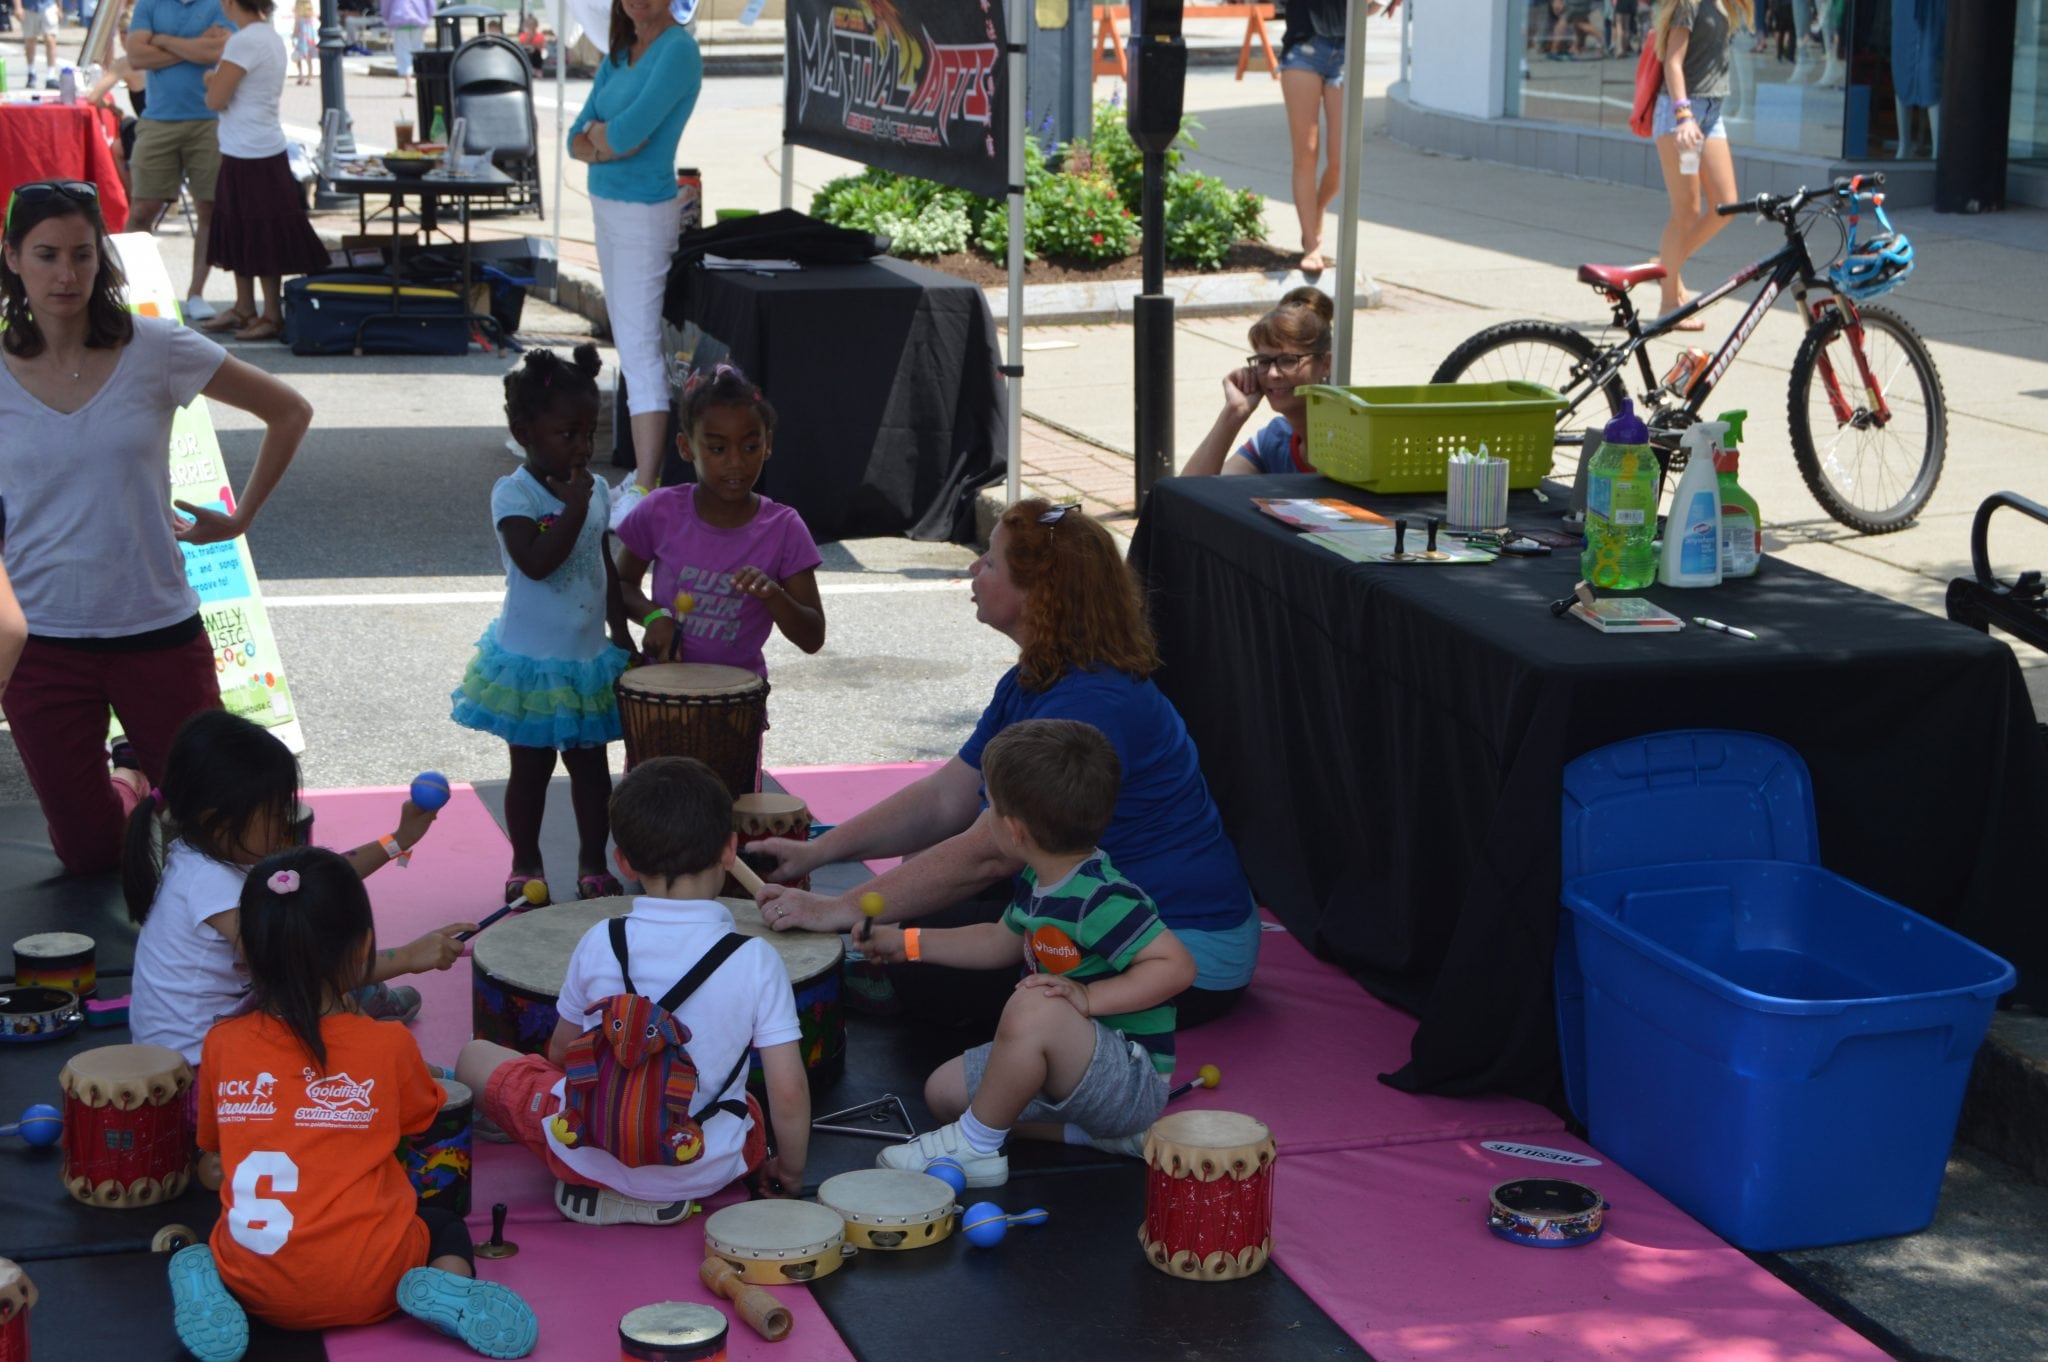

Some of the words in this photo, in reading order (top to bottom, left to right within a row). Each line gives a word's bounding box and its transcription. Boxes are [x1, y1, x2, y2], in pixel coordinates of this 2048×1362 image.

[796, 8, 914, 127] MARTIAL
[910, 23, 999, 146] ARTS
[677, 566, 736, 595] PUS
[203, 606, 241, 632] MILY
[212, 626, 246, 650] USIC
[311, 1083, 367, 1101] goldfish
[295, 1107, 331, 1120] swim
[333, 1107, 374, 1122] school
[1490, 1143, 1572, 1161] RESILITE
[228, 1151, 299, 1256] 6
